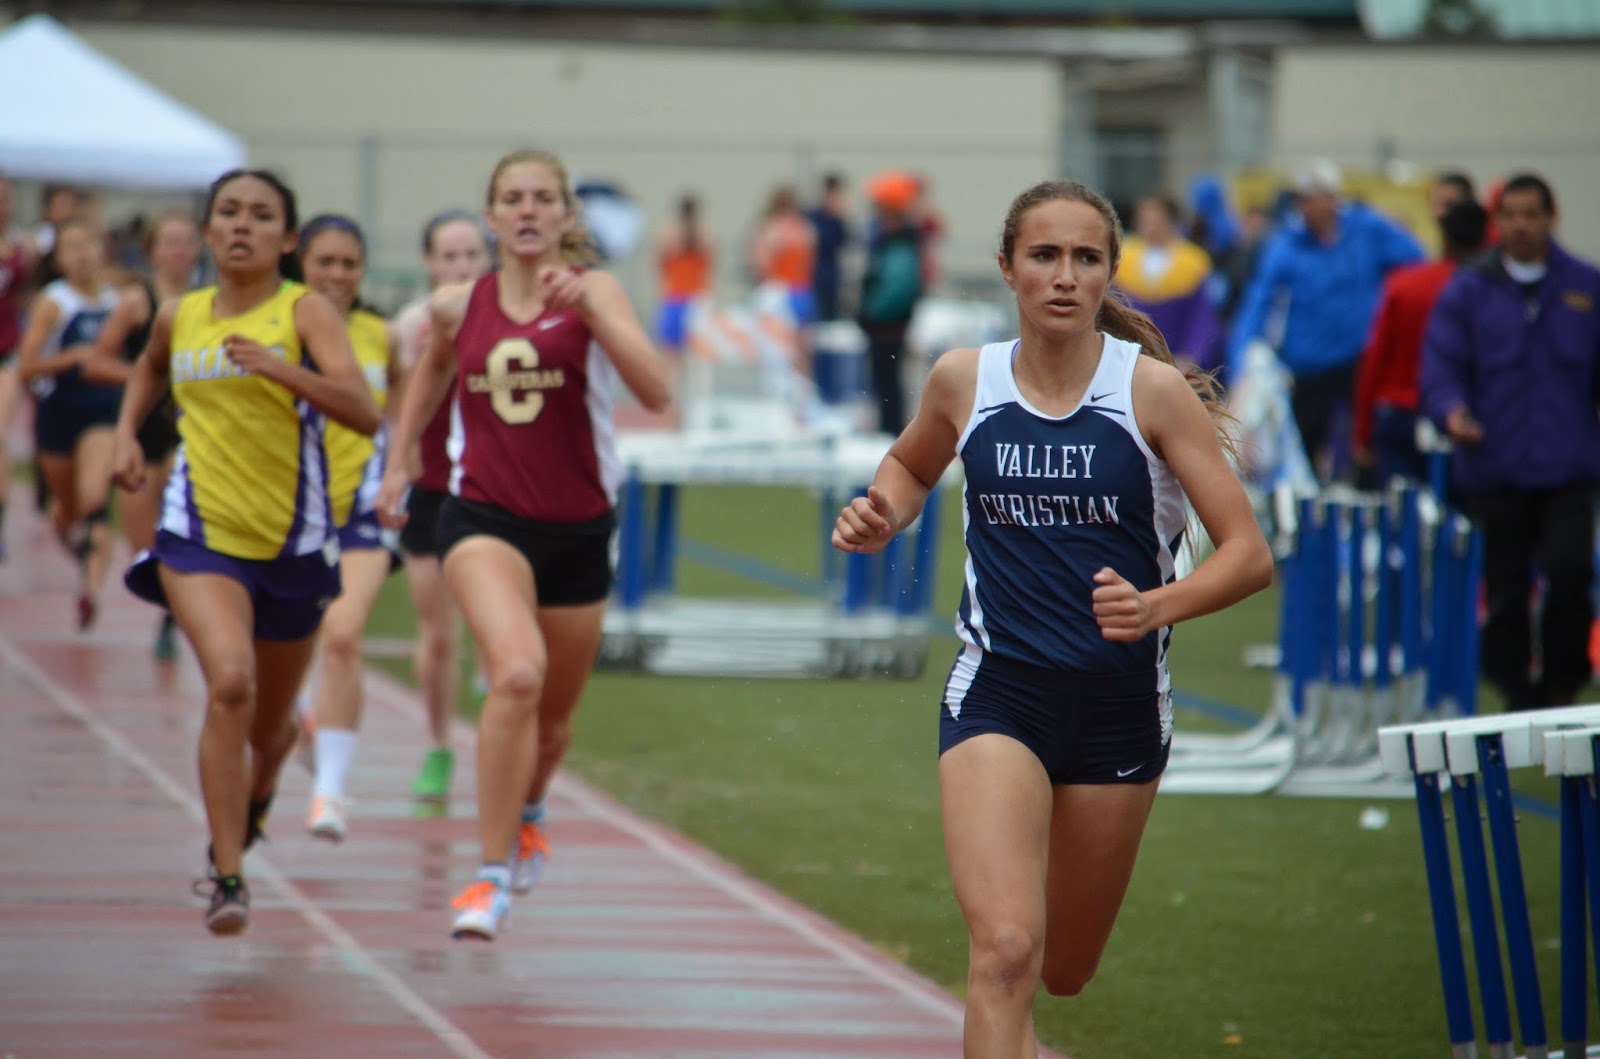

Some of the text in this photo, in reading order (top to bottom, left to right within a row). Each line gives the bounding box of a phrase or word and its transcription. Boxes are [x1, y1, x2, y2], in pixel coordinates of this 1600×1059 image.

[486, 338, 544, 425] C
[996, 443, 1097, 478] VALLEY
[979, 494, 1119, 527] CHRISTIAN
